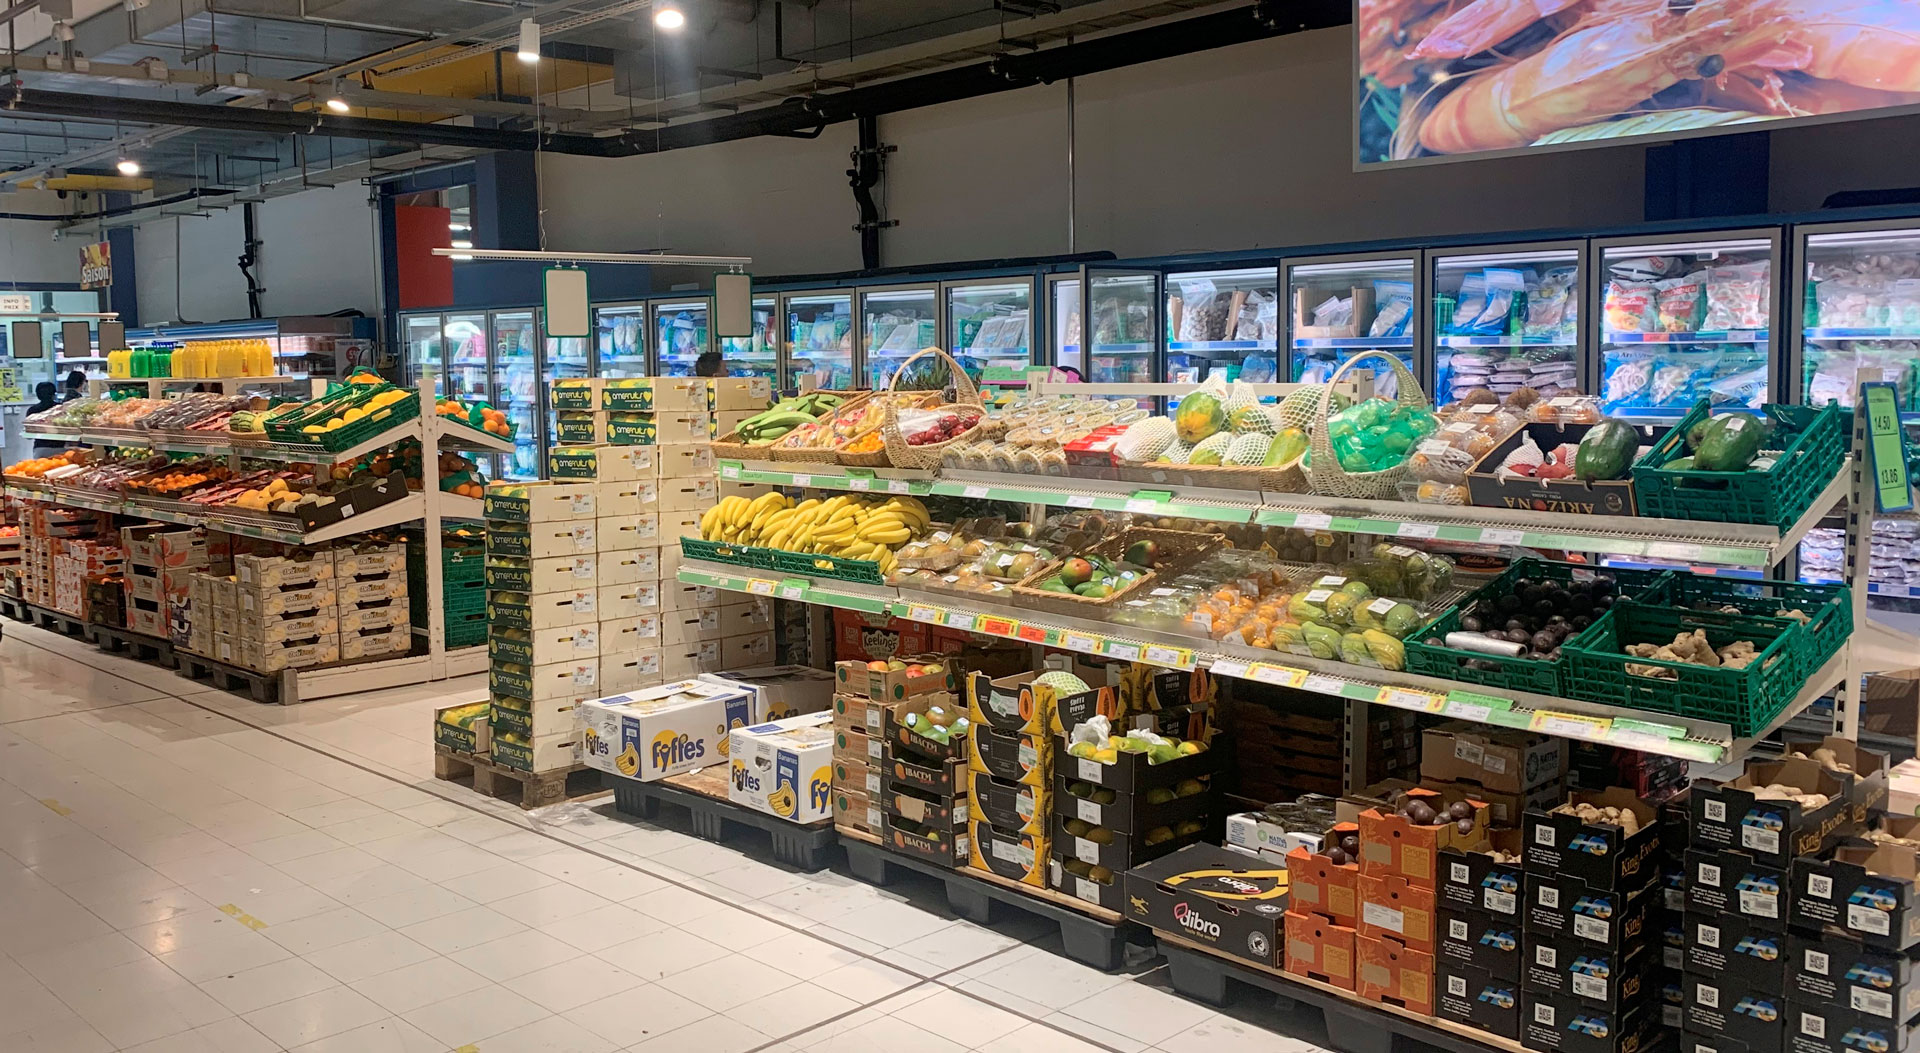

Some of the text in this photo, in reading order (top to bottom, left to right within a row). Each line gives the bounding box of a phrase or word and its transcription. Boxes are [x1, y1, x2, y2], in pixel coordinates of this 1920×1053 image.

[82, 265, 109, 284] Saison
[1874, 415, 1891, 431] 14.50
[864, 631, 897, 652] Keelings
[726, 700, 747, 710] Bananas
[622, 718, 640, 729] Bananas
[585, 732, 609, 756] Fyffes
[652, 737, 705, 772] Fyffes
[777, 752, 798, 765] Bananas
[732, 765, 760, 792] Fyffes
[1799, 810, 1847, 857] King Exotic
[1621, 854, 1641, 879] King
[1177, 907, 1221, 937] dibra
